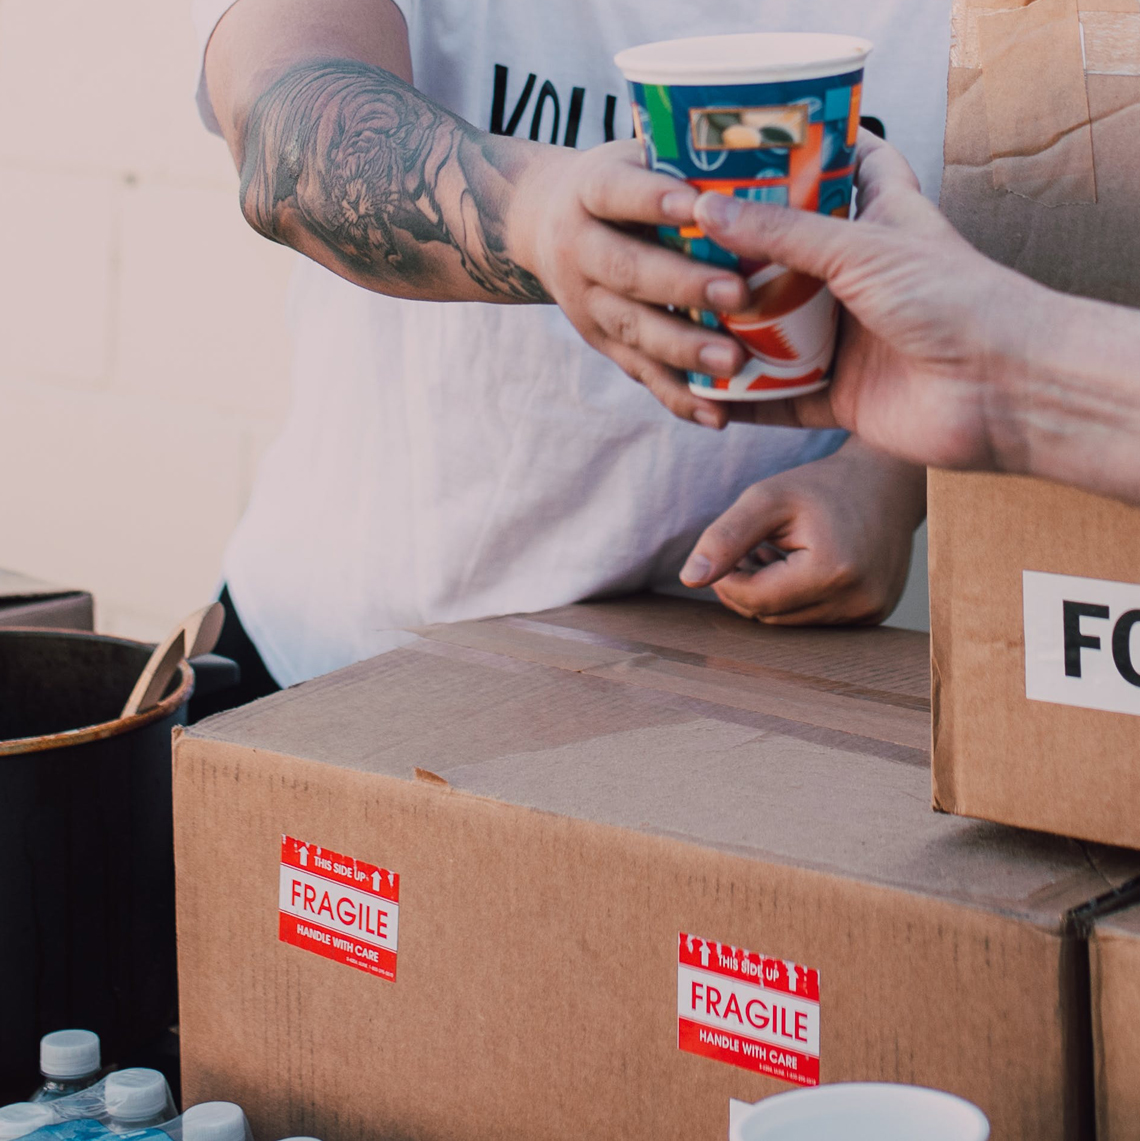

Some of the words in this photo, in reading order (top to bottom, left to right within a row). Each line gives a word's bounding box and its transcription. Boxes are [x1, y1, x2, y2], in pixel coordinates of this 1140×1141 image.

[314, 856, 332, 871] THIS
[333, 863, 352, 878] SIDE
[354, 868, 366, 882] UP
[291, 879, 388, 939] FRAGILE
[296, 924, 331, 945] HANDLE
[332, 936, 354, 953] WITH
[355, 945, 379, 963] CARE
[718, 954, 738, 972] THIS
[741, 959, 763, 977] SIDE
[766, 966, 780, 982] UP
[691, 981, 807, 1043] FRAGILE
[699, 1029, 740, 1053] HANDLE
[742, 1041, 767, 1061] WITH
[769, 1049, 798, 1070] CARE
